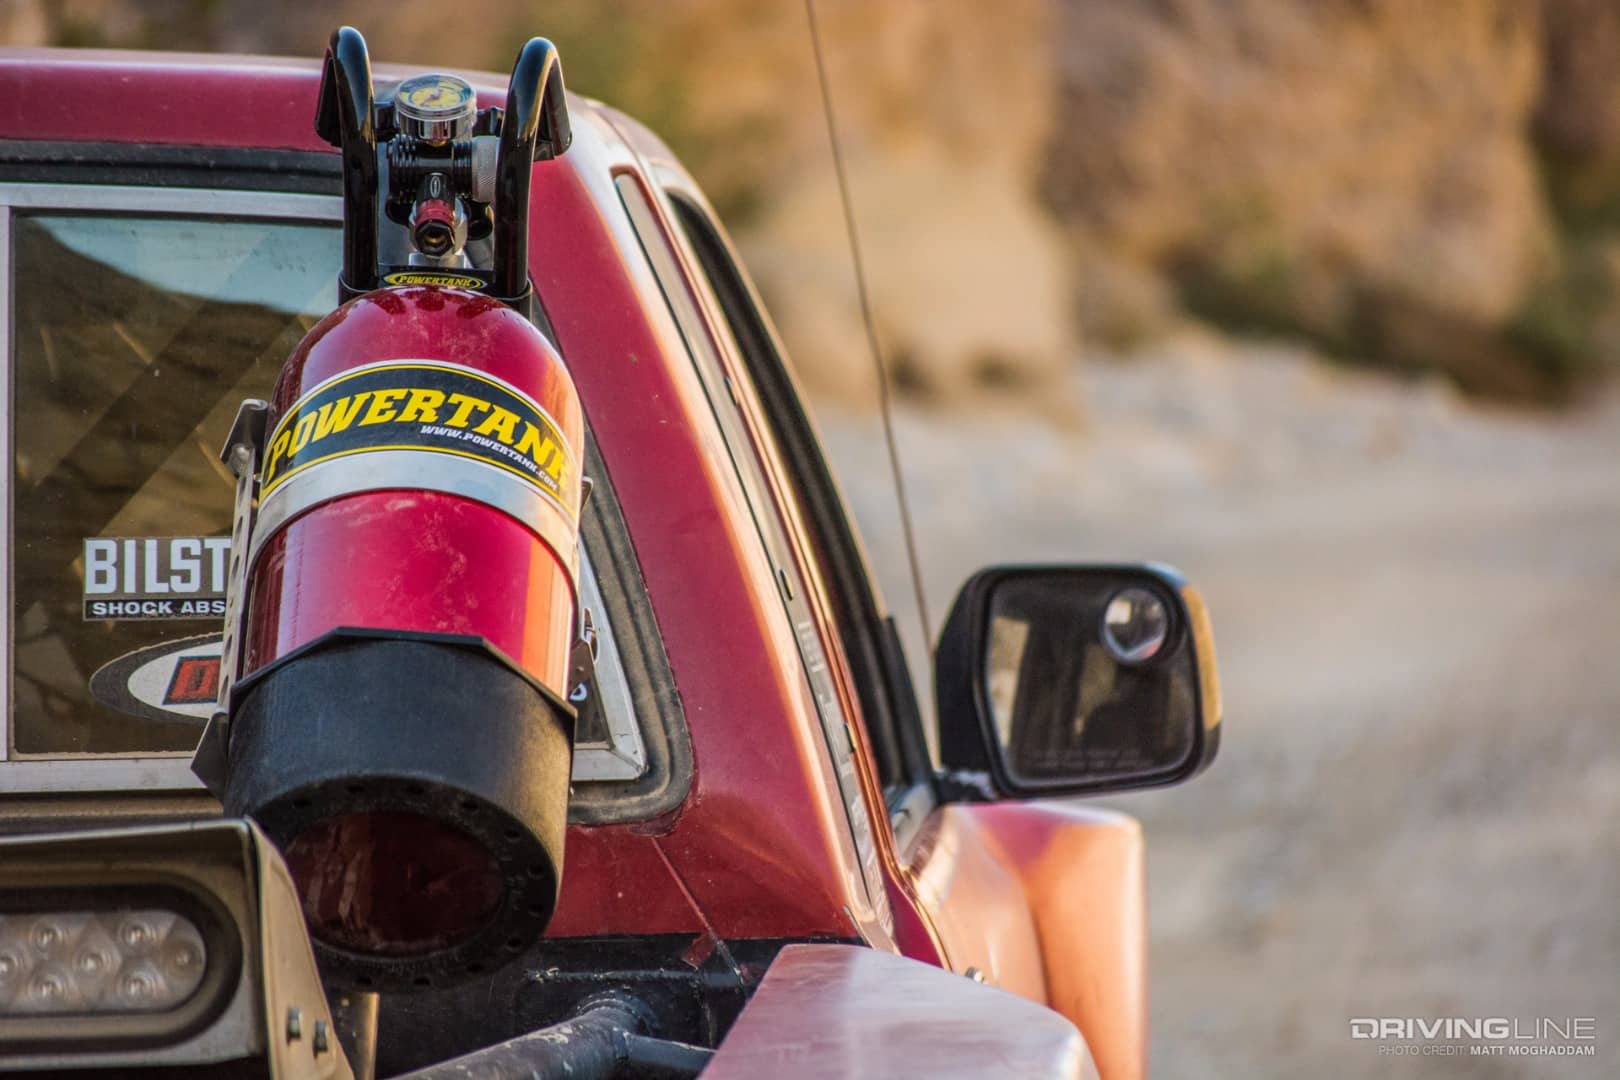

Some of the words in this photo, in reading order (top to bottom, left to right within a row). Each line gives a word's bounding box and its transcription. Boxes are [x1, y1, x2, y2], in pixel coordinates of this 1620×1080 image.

[398, 275, 472, 286] POWERTANK
[85, 539, 231, 593] BILST
[92, 602, 173, 615] SHOCK
[180, 601, 226, 613] ABS
